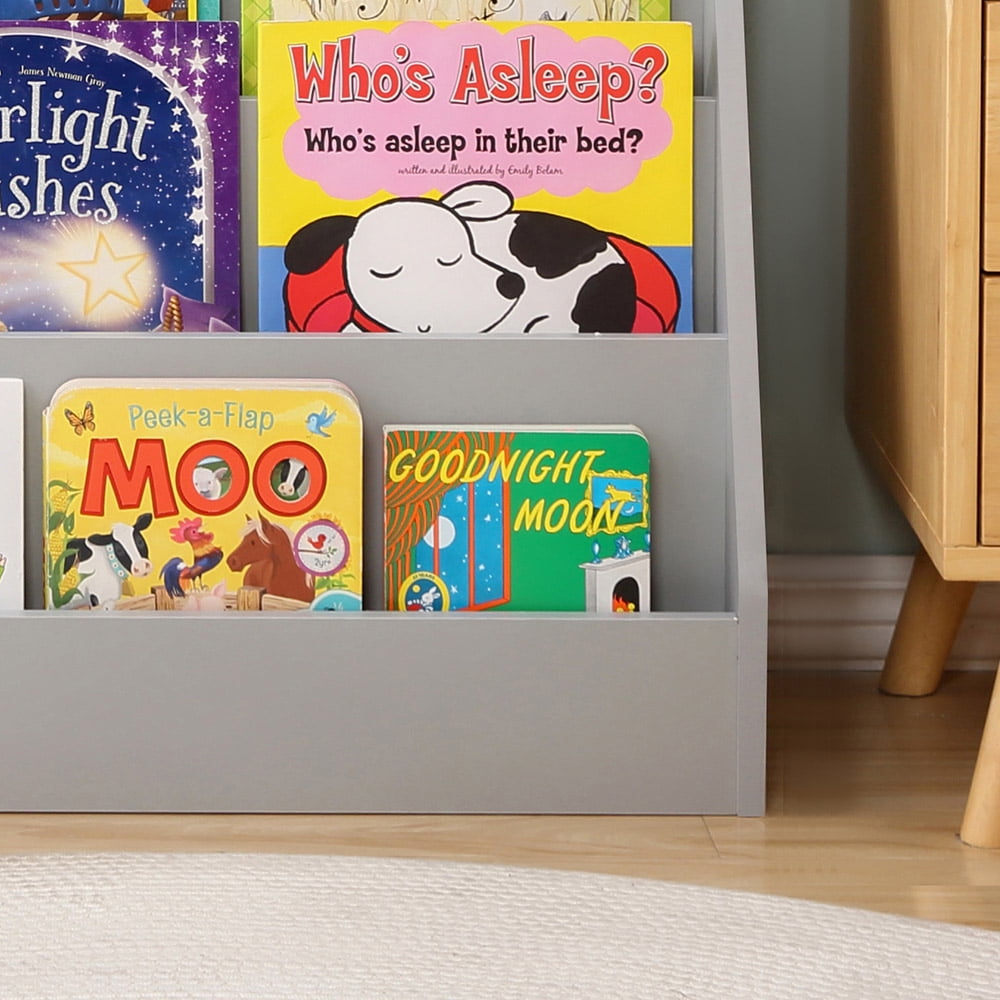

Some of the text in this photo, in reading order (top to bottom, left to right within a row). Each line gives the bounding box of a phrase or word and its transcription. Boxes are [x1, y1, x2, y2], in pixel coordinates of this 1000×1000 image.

[18, 65, 106, 90] James Newman Gray
[288, 34, 670, 124] Who's Asleep?
[304, 125, 644, 161] Who's asleep in their bed?
[398, 164, 428, 175] written
[429, 164, 446, 175] and
[448, 164, 493, 175] illustrated
[495, 164, 506, 178] by
[507, 164, 533, 178] Emily
[128, 401, 275, 435] Peek-a-Flap
[79, 438, 328, 518] MOO
[389, 448, 606, 484] GOODNIGHT
[513, 498, 626, 534] MOON
